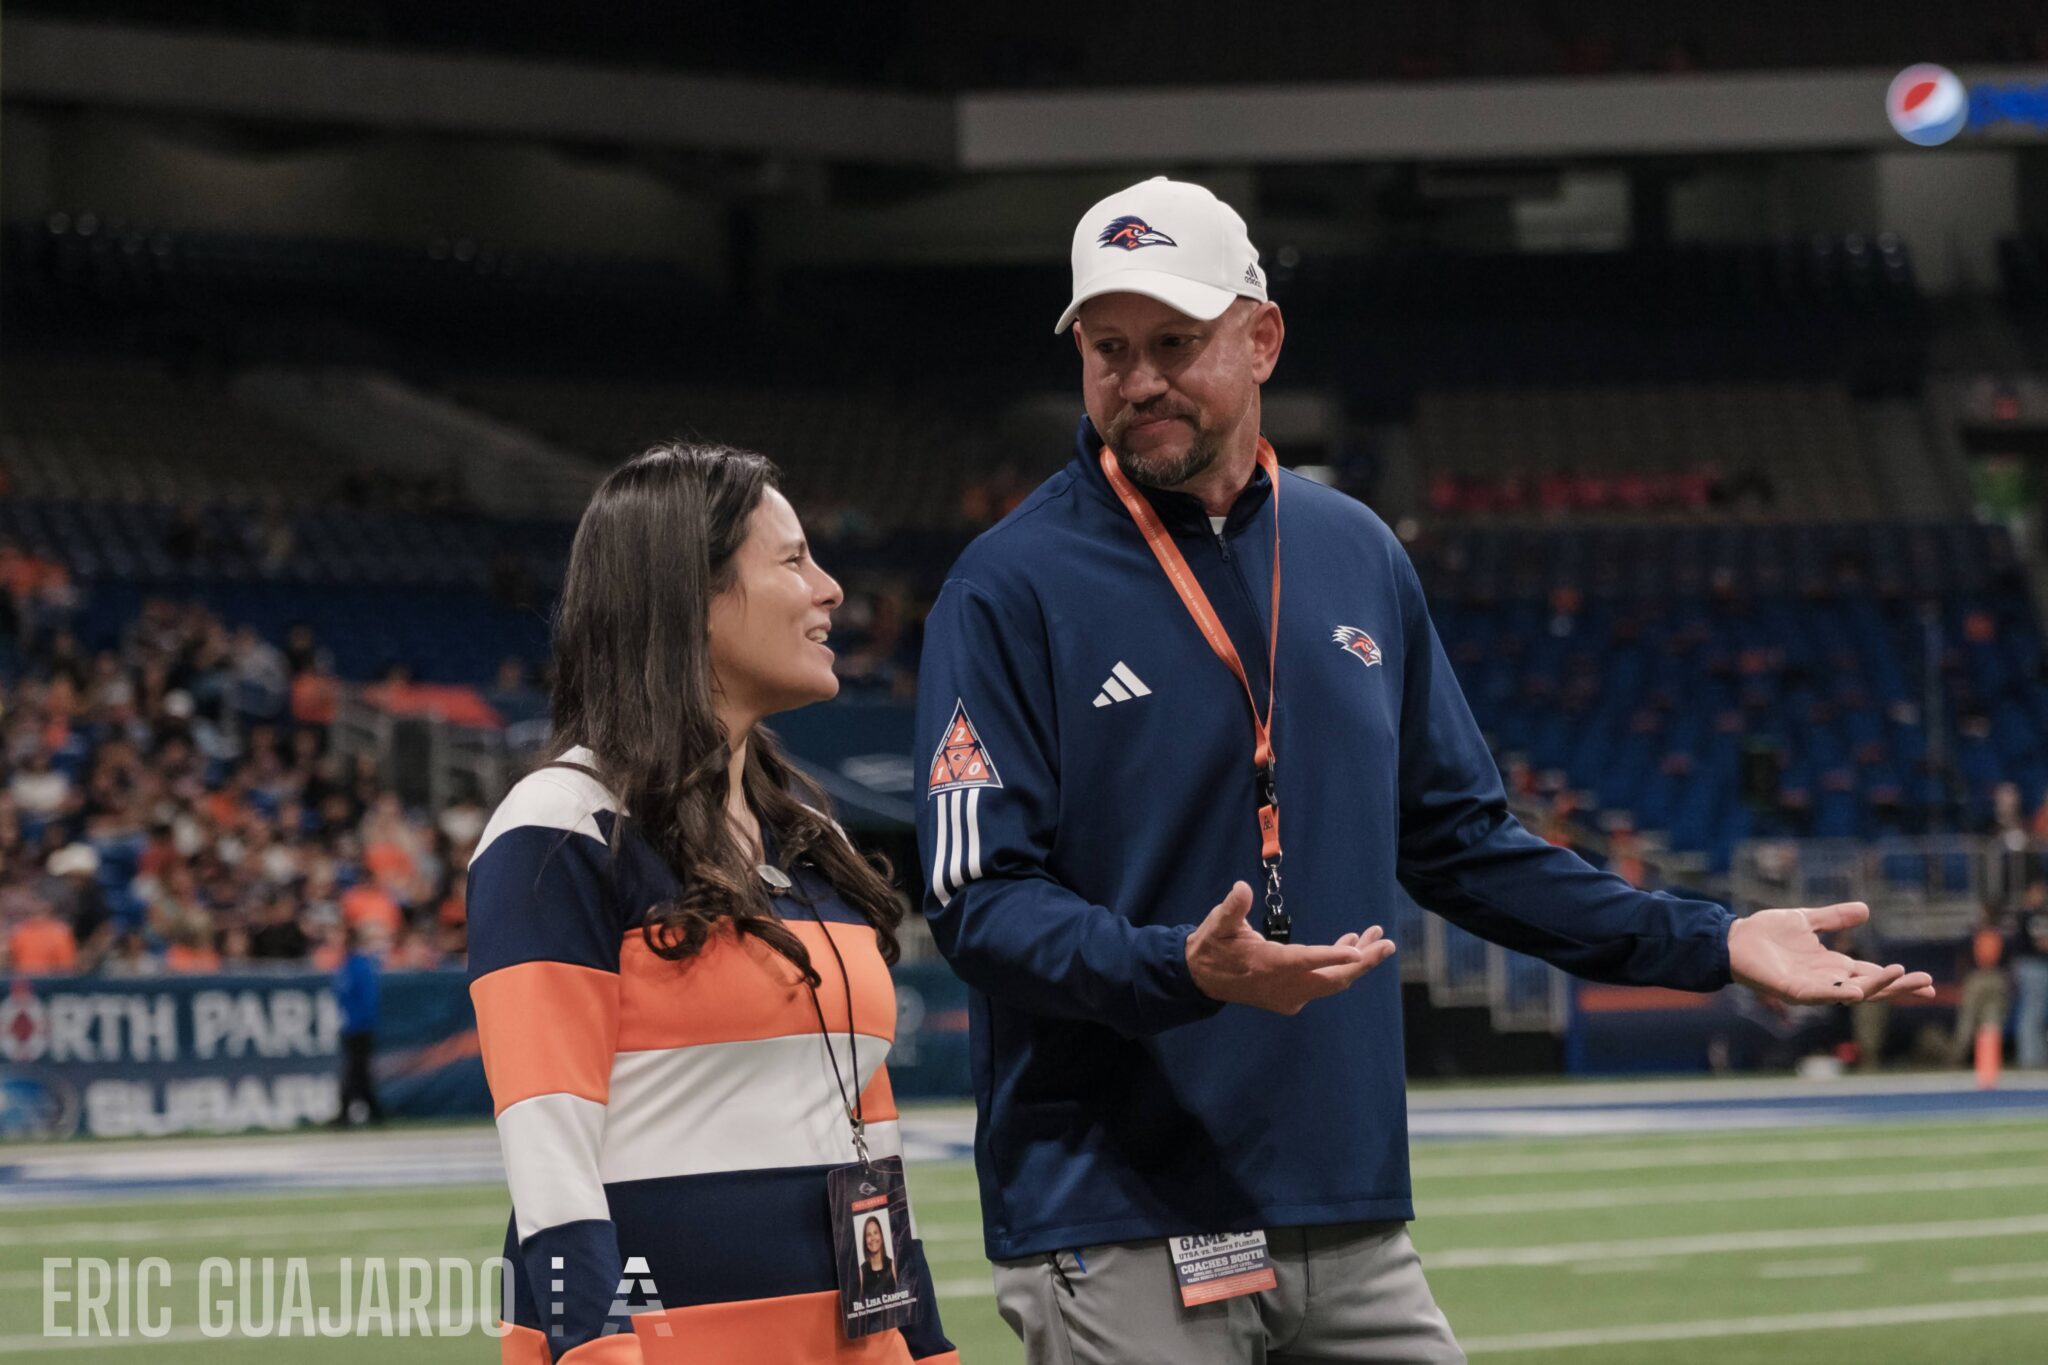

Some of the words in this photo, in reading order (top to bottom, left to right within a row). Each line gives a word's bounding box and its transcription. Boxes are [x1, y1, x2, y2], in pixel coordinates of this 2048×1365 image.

[954, 727, 966, 742] 2
[936, 766, 944, 780] 1
[968, 762, 981, 776] 0
[1181, 1232, 1228, 1251] GAME
[1179, 1251, 1200, 1260] UTSA
[1181, 1256, 1228, 1275] COACHES
[1229, 1249, 1264, 1265] BOOTH
